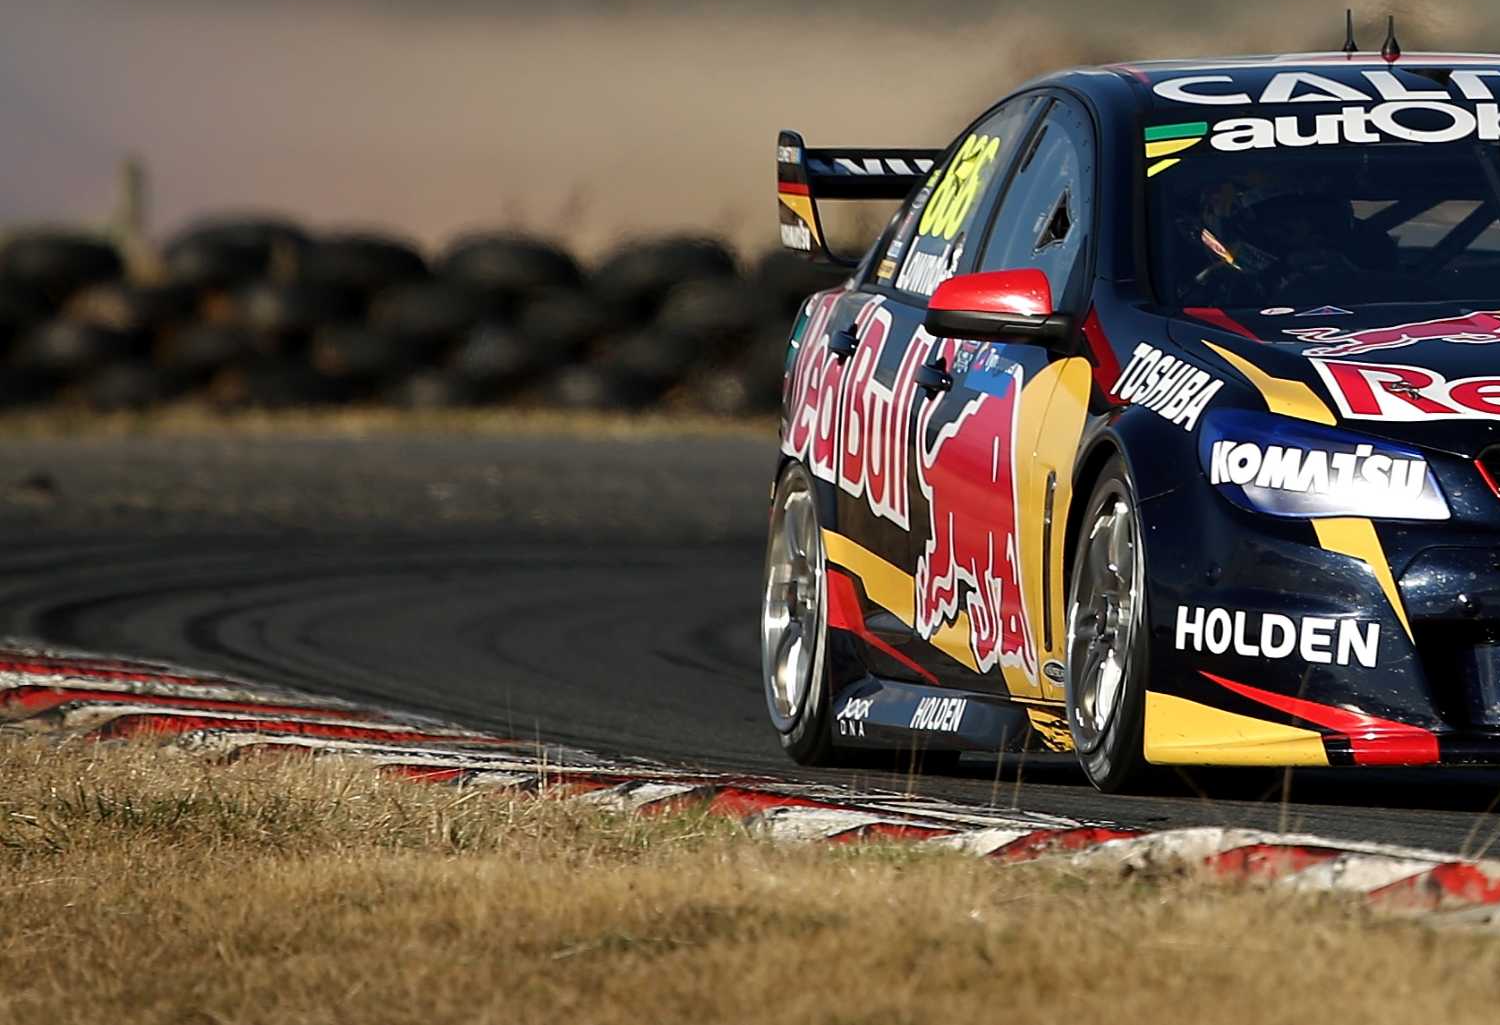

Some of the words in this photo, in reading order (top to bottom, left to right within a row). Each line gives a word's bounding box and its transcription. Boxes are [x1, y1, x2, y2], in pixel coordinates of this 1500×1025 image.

[838, 304, 937, 533] Bull
[1109, 342, 1225, 432] TOSHIBA
[1210, 440, 1428, 502] KOMATSU
[1175, 605, 1382, 668] HOLDEN
[909, 696, 968, 733] HOLDEN
